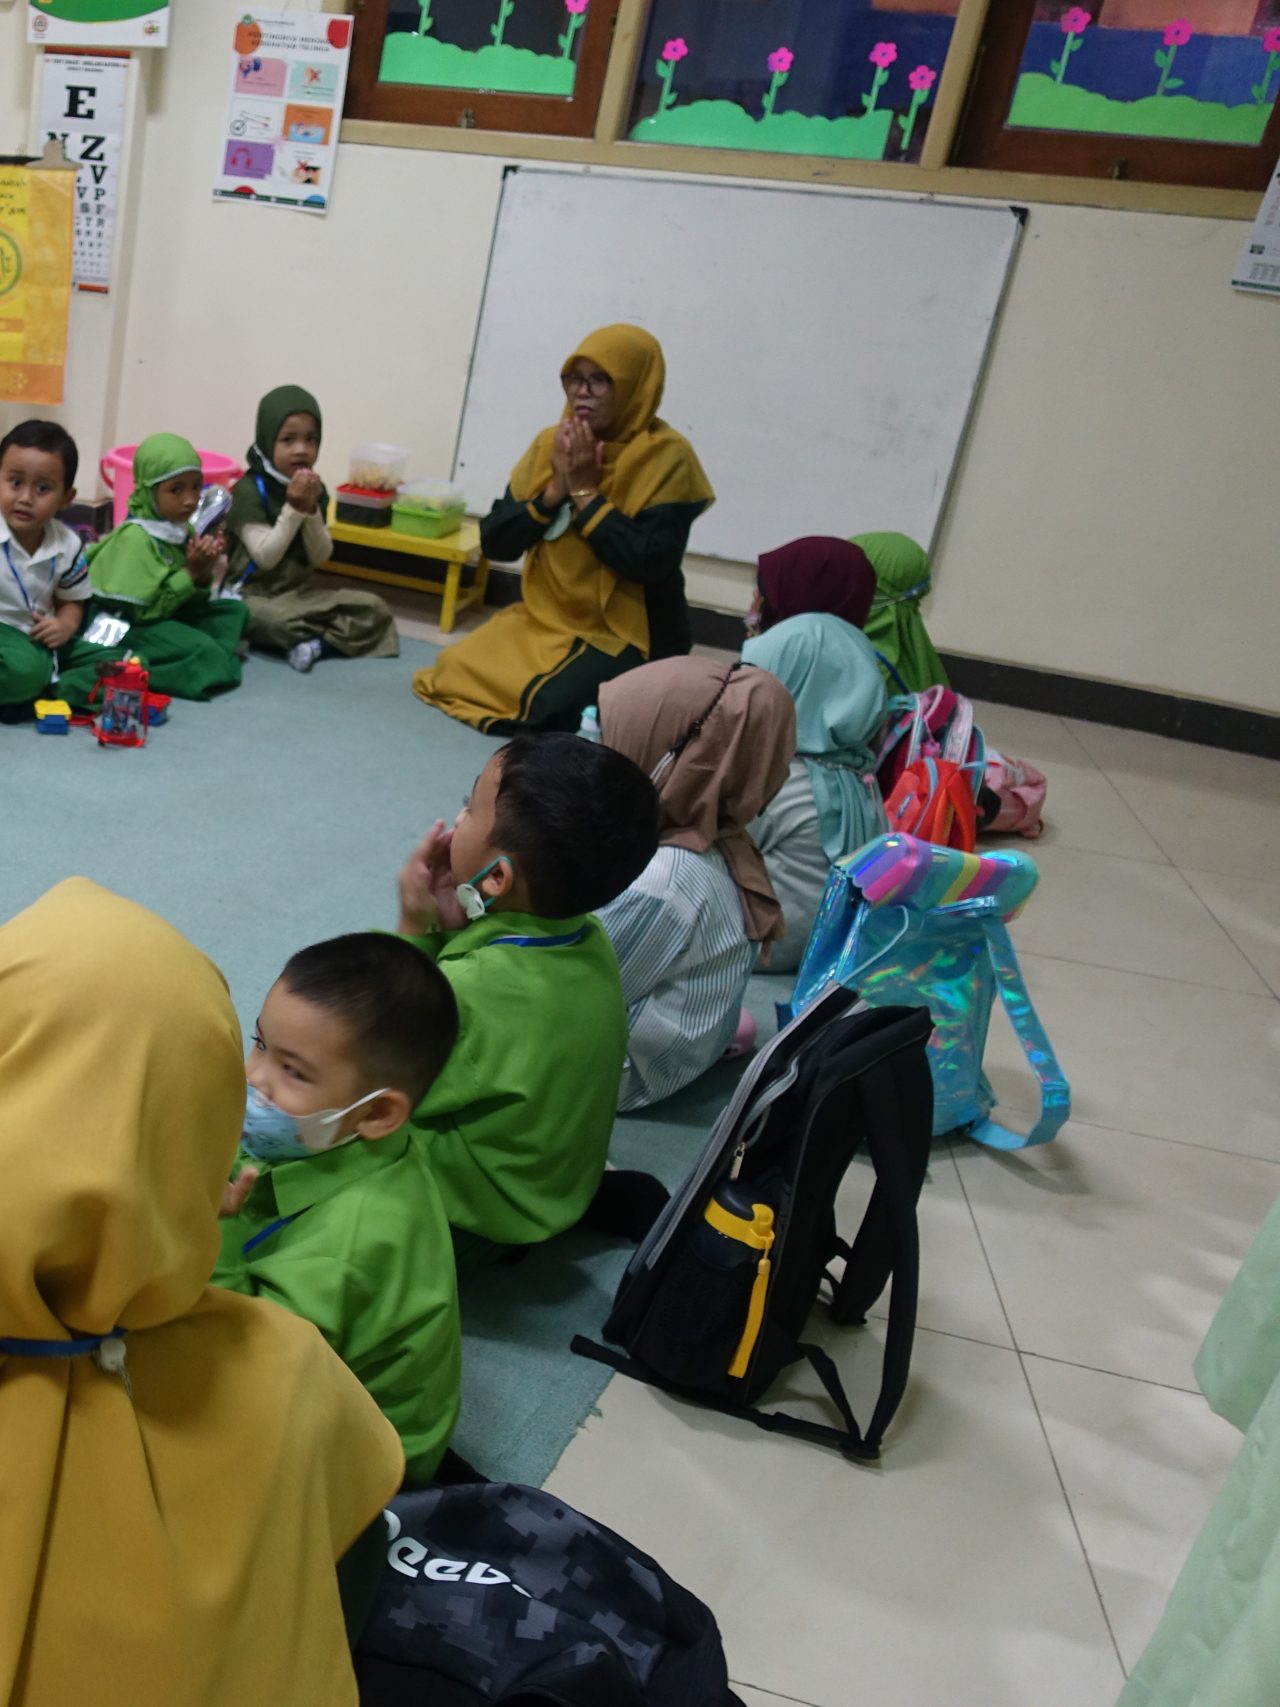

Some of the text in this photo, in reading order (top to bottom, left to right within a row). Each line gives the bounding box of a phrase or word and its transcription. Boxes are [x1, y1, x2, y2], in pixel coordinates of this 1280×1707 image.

[63, 85, 96, 119] E
[80, 134, 106, 161] Z
[91, 164, 108, 184] V
[94, 187, 106, 201] P
